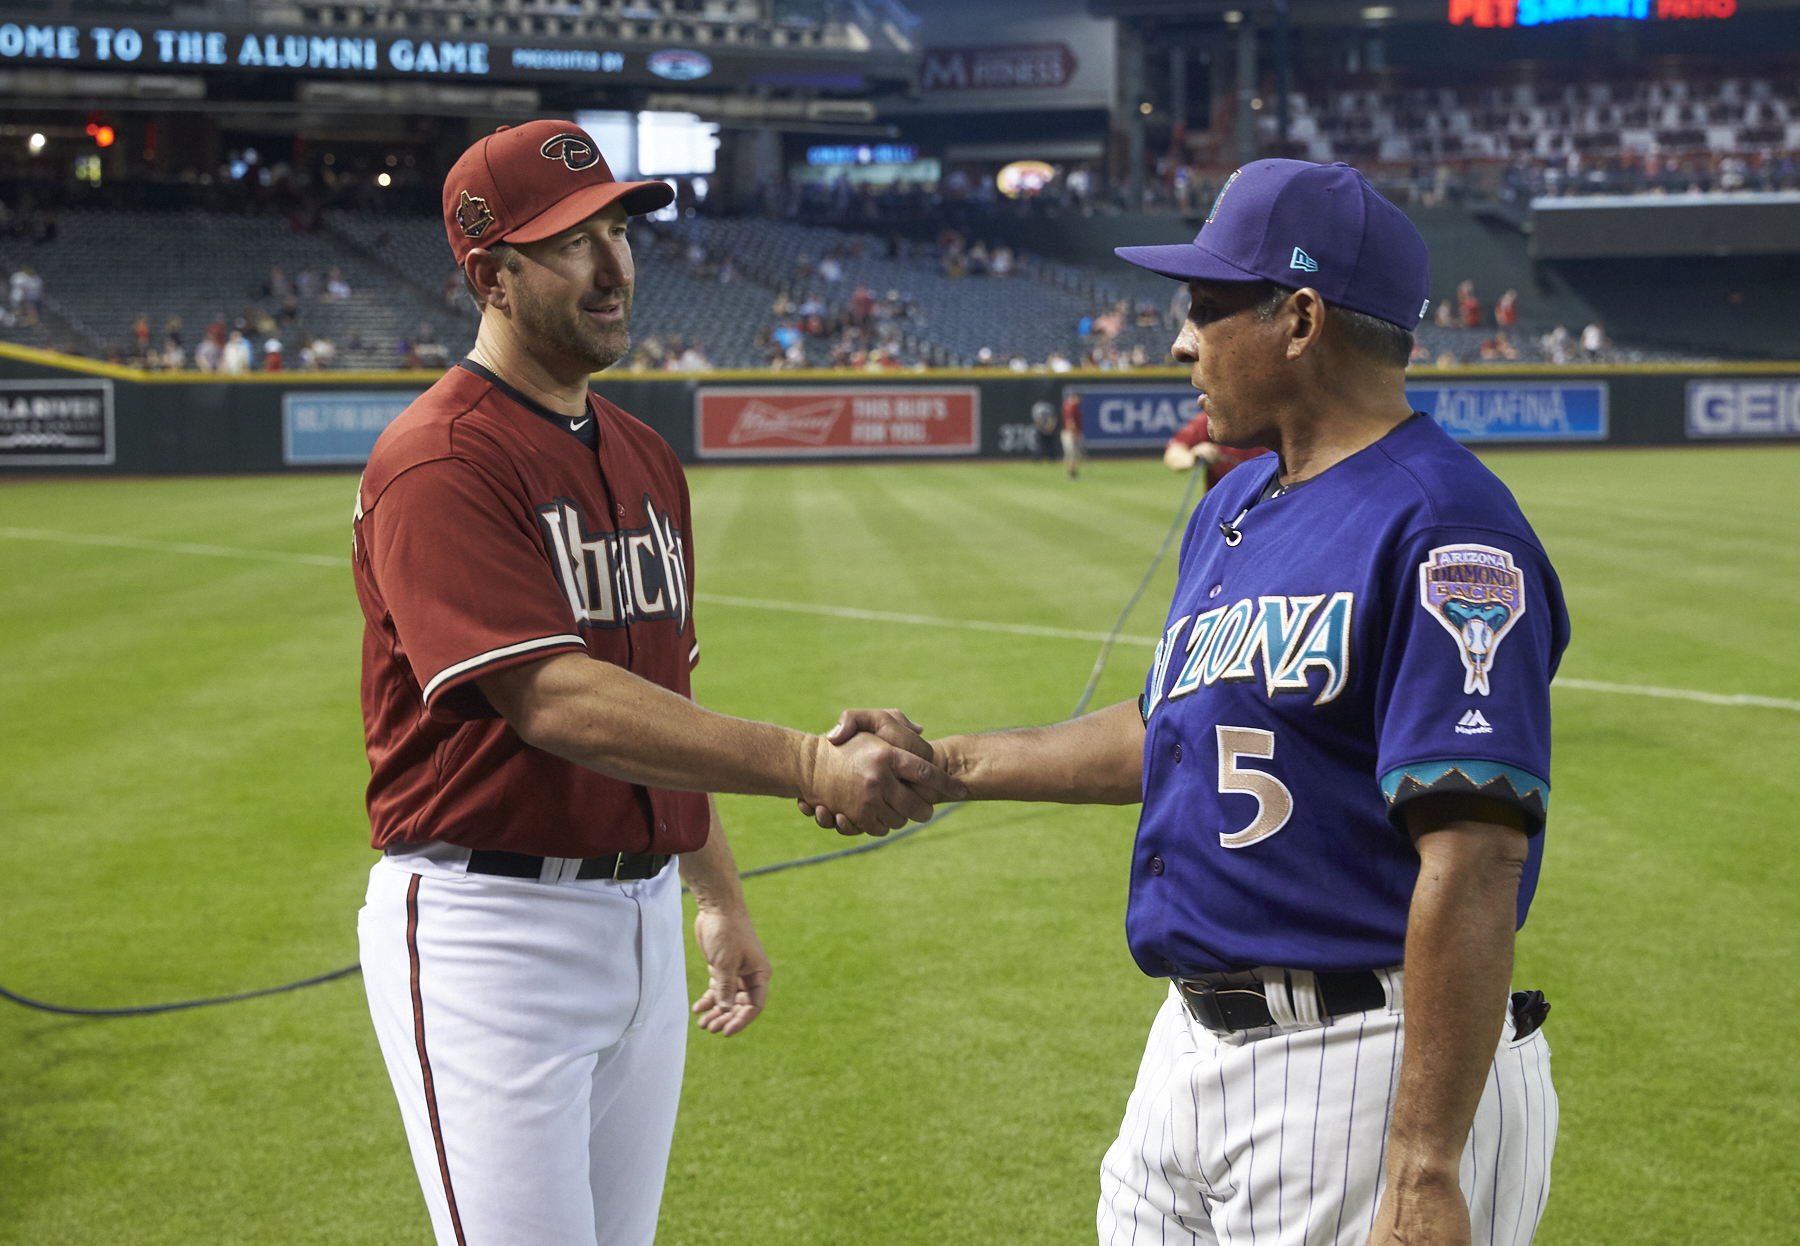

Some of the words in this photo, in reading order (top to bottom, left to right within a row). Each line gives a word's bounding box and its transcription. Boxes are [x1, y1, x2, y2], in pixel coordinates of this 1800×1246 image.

[0, 22, 80, 59] OME
[90, 27, 142, 61] TO
[153, 30, 227, 64] THE
[238, 34, 378, 70] ALUMNI
[388, 39, 490, 74] GAME
[1434, 387, 1571, 436] AQUAFINA
[1432, 564, 1514, 588] DIAMOND
[1439, 551, 1506, 569] ARIZONA
[1436, 584, 1514, 602] BACKS
[1147, 591, 1355, 719] IZONA
[1454, 725, 1493, 735] Majestic
[1216, 725, 1294, 849] 5
